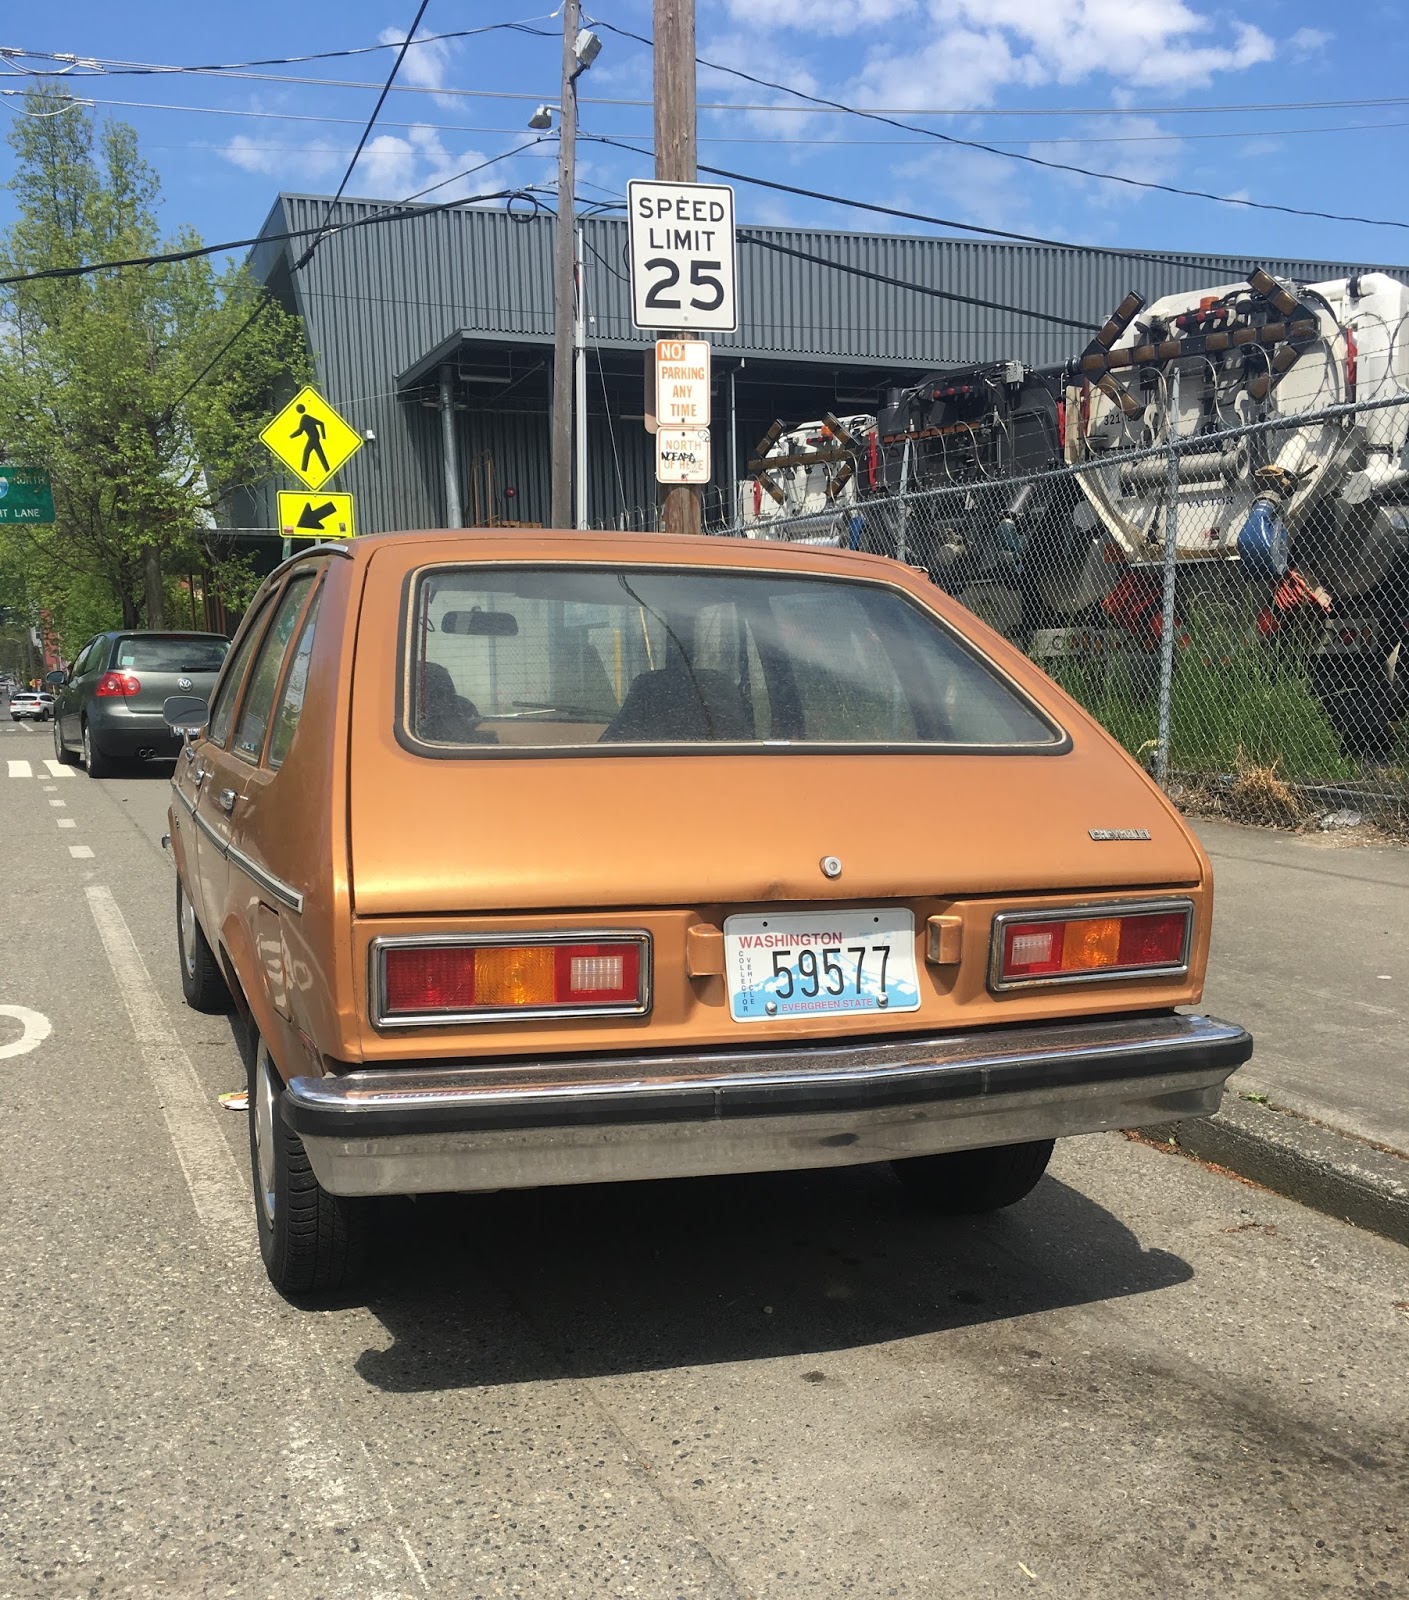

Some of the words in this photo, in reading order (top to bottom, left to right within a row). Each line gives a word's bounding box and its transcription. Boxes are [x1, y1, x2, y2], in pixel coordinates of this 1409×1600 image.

[639, 197, 725, 222] SPEED
[650, 228, 715, 251] LIMIT
[644, 257, 725, 311] 25
[661, 343, 682, 359] NO
[661, 366, 705, 380] PARKING
[672, 385, 692, 398] ANY
[670, 403, 697, 417] TIME
[665, 440, 702, 450] NORTH
[1187, 496, 1234, 508] VACTOR
[14, 508, 41, 518] LANE
[738, 931, 843, 949] WASHINGTON
[772, 945, 890, 999] 59577
[738, 950, 749, 1012] COLLECTOR
[747, 957, 755, 1005] VEHICLE
[781, 1000, 840, 1012] EVERGREEN
[843, 998, 873, 1008] STATE
